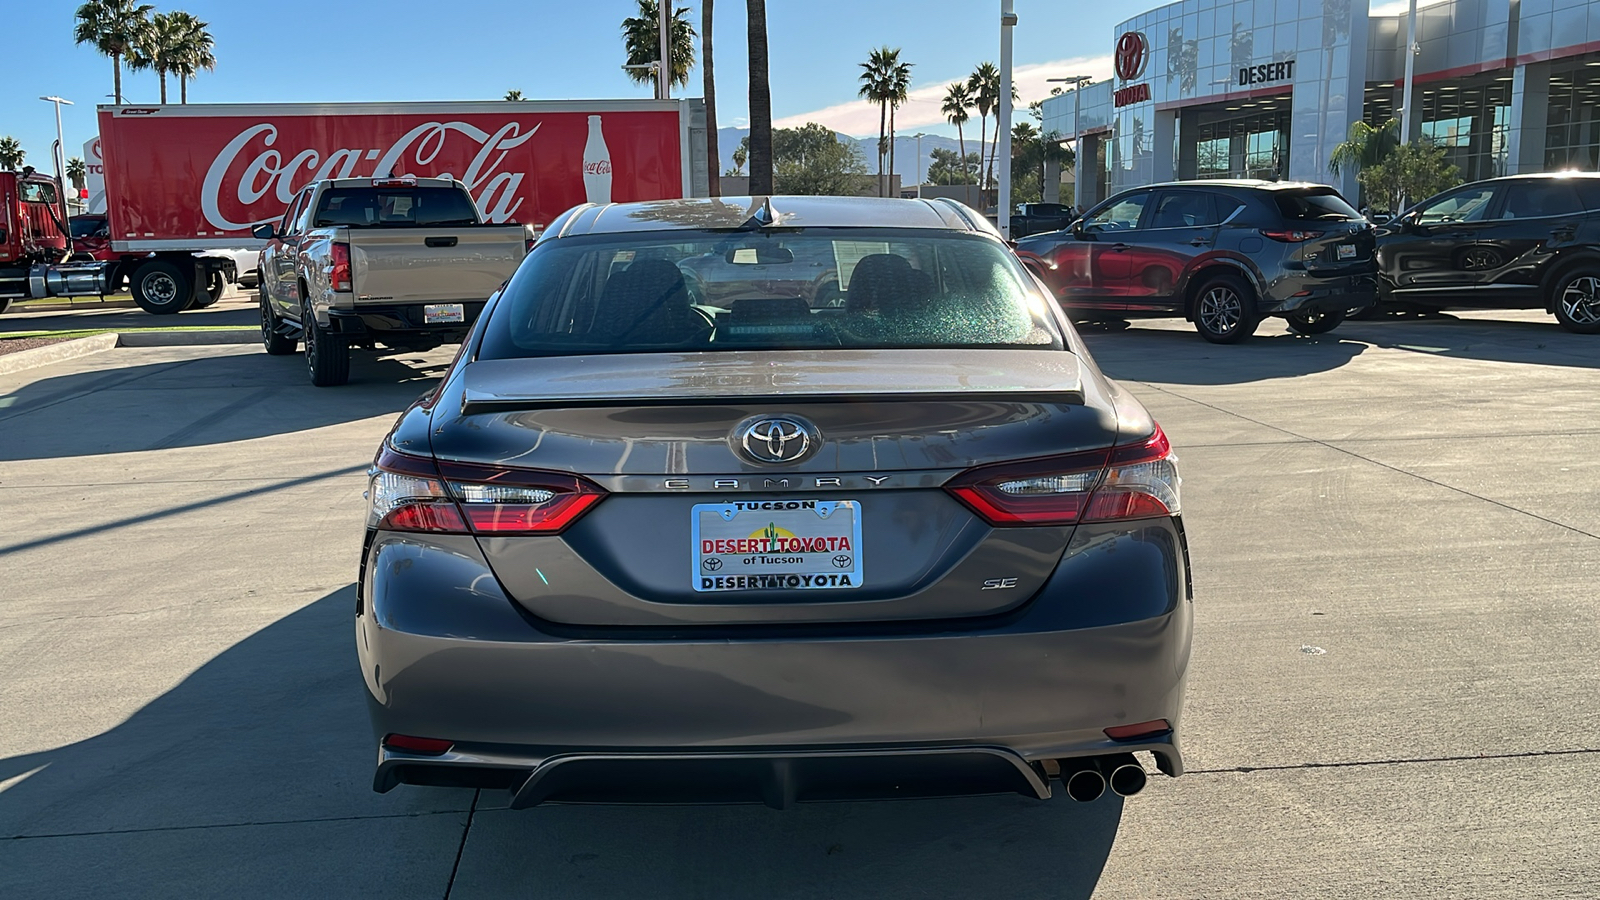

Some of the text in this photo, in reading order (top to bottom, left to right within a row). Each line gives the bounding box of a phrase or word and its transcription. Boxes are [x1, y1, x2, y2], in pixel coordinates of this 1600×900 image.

[1239, 60, 1295, 86] DESERT
[1114, 84, 1151, 107] TOYOTA
[584, 160, 611, 175] oca-Cola
[201, 121, 541, 230] Coca-Cla
[665, 475, 892, 489] CAMRY
[735, 501, 816, 511] TUCSON
[702, 536, 851, 554] DESERT TOYOTA
[743, 555, 804, 565] of Tucson
[702, 574, 852, 590] DESERT TOYOTA
[981, 577, 1018, 591] SE
